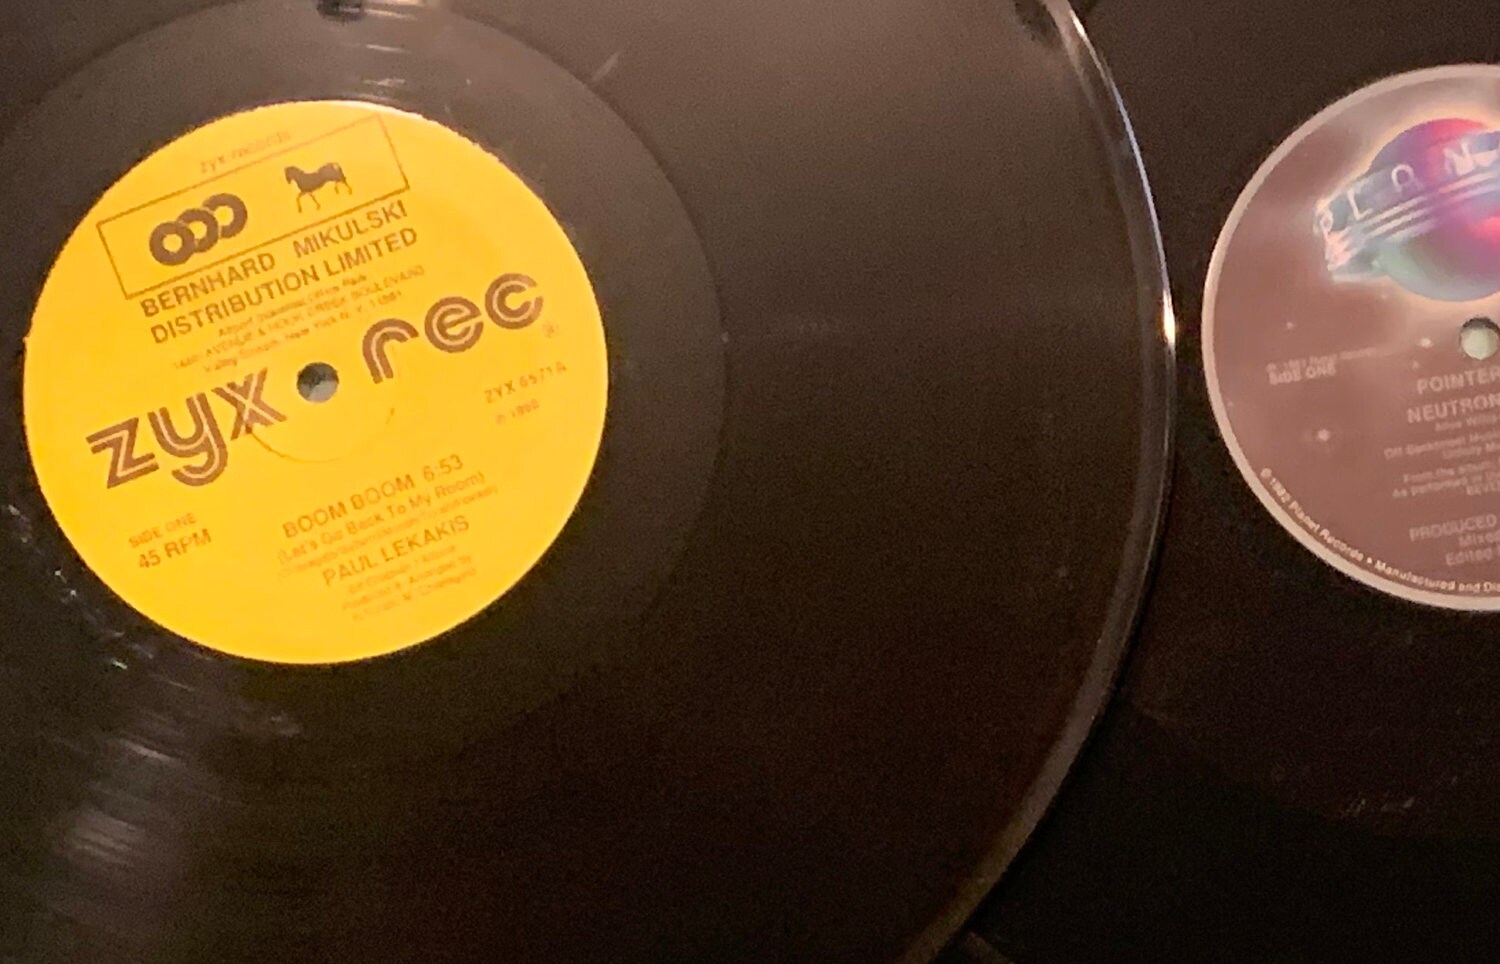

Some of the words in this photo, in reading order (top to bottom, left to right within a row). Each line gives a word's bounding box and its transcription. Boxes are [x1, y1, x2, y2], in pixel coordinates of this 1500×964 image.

[140, 253, 275, 318] BERNHARD
[293, 200, 408, 258] MIKULSKI
[151, 266, 320, 344] DISTRIBUTION
[326, 228, 417, 276] LIMITED
[362, 273, 544, 384] rec
[86, 367, 287, 489] zyx
[282, 502, 347, 539] BOOM
[350, 473, 415, 512] BOOM
[422, 453, 464, 483] 6:53
[1409, 514, 1497, 541] PRODUCED
[138, 550, 161, 569] 45
[164, 528, 212, 559] RPM
[322, 556, 380, 587] PAUL
[381, 515, 470, 563] LEKAKIS
[1375, 559, 1455, 590] Manufactured
[1458, 580, 1481, 593] and
